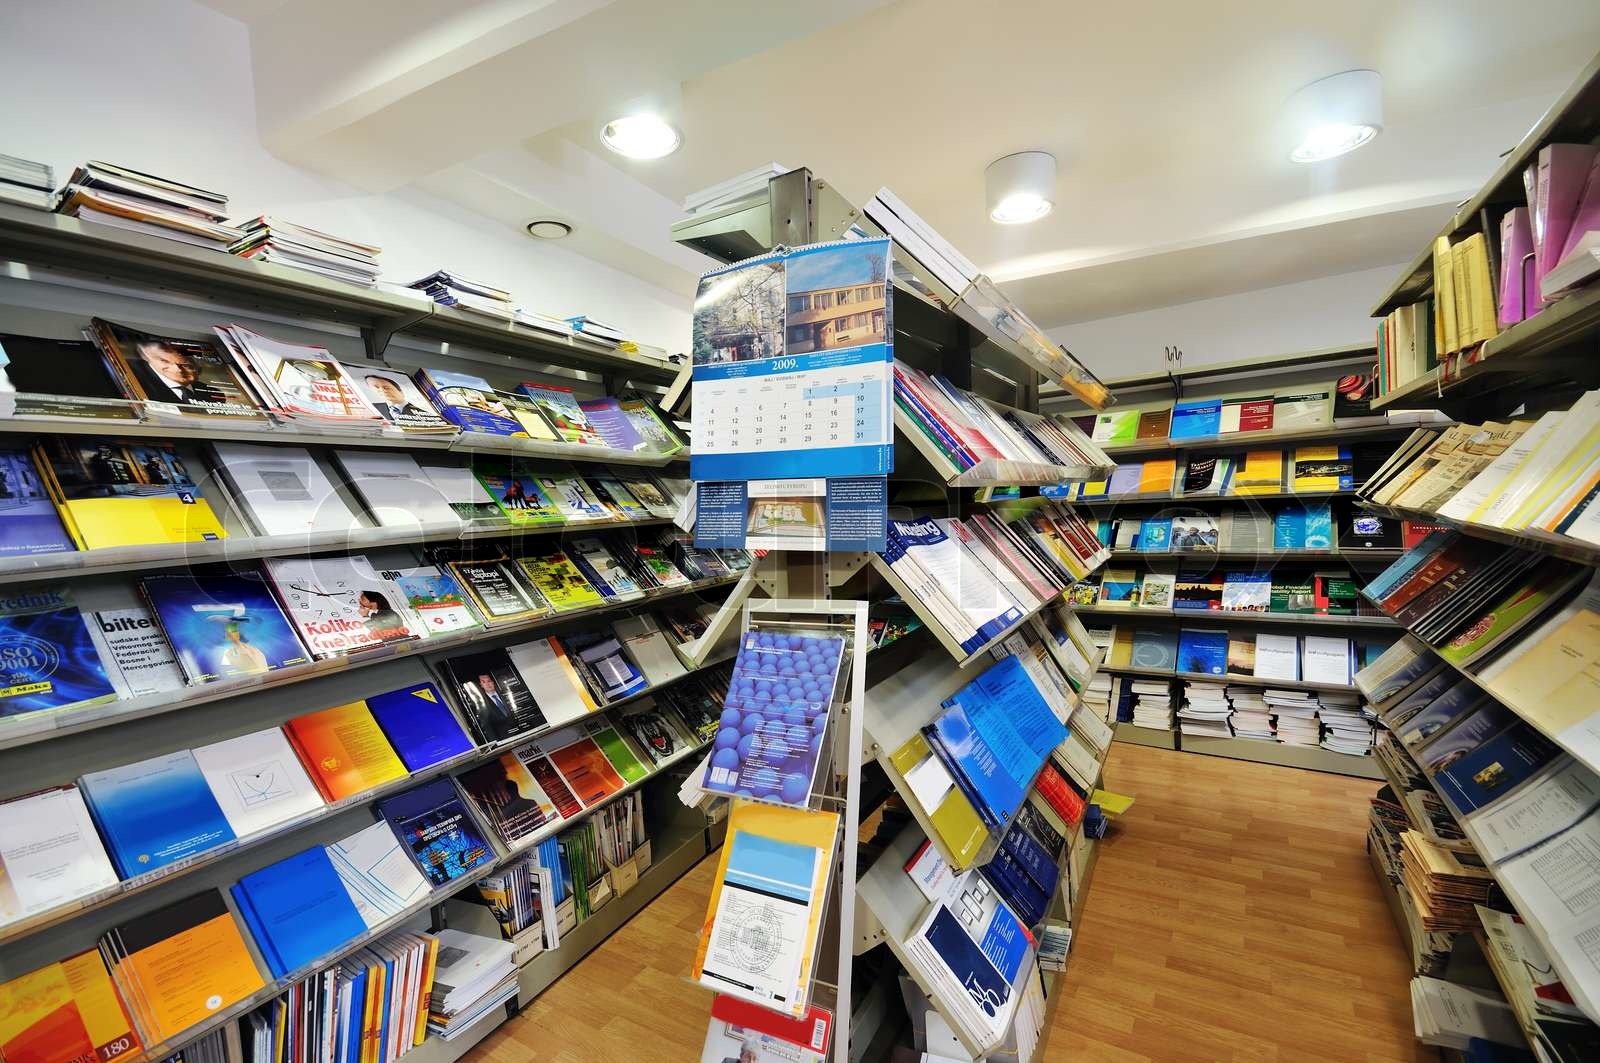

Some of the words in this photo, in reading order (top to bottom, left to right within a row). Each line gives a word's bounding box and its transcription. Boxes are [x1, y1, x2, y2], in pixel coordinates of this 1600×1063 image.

[772, 358, 799, 370] 2009.
[181, 494, 192, 502] 4
[304, 618, 364, 636] Koliko
[110, 636, 139, 644] sudske
[0, 646, 32, 660] SO
[112, 643, 153, 652] Vrhovnog
[116, 648, 160, 658] Federacije
[120, 657, 146, 665] Bosne
[123, 659, 175, 672] Hercegovine
[104, 1038, 130, 1058] 180
